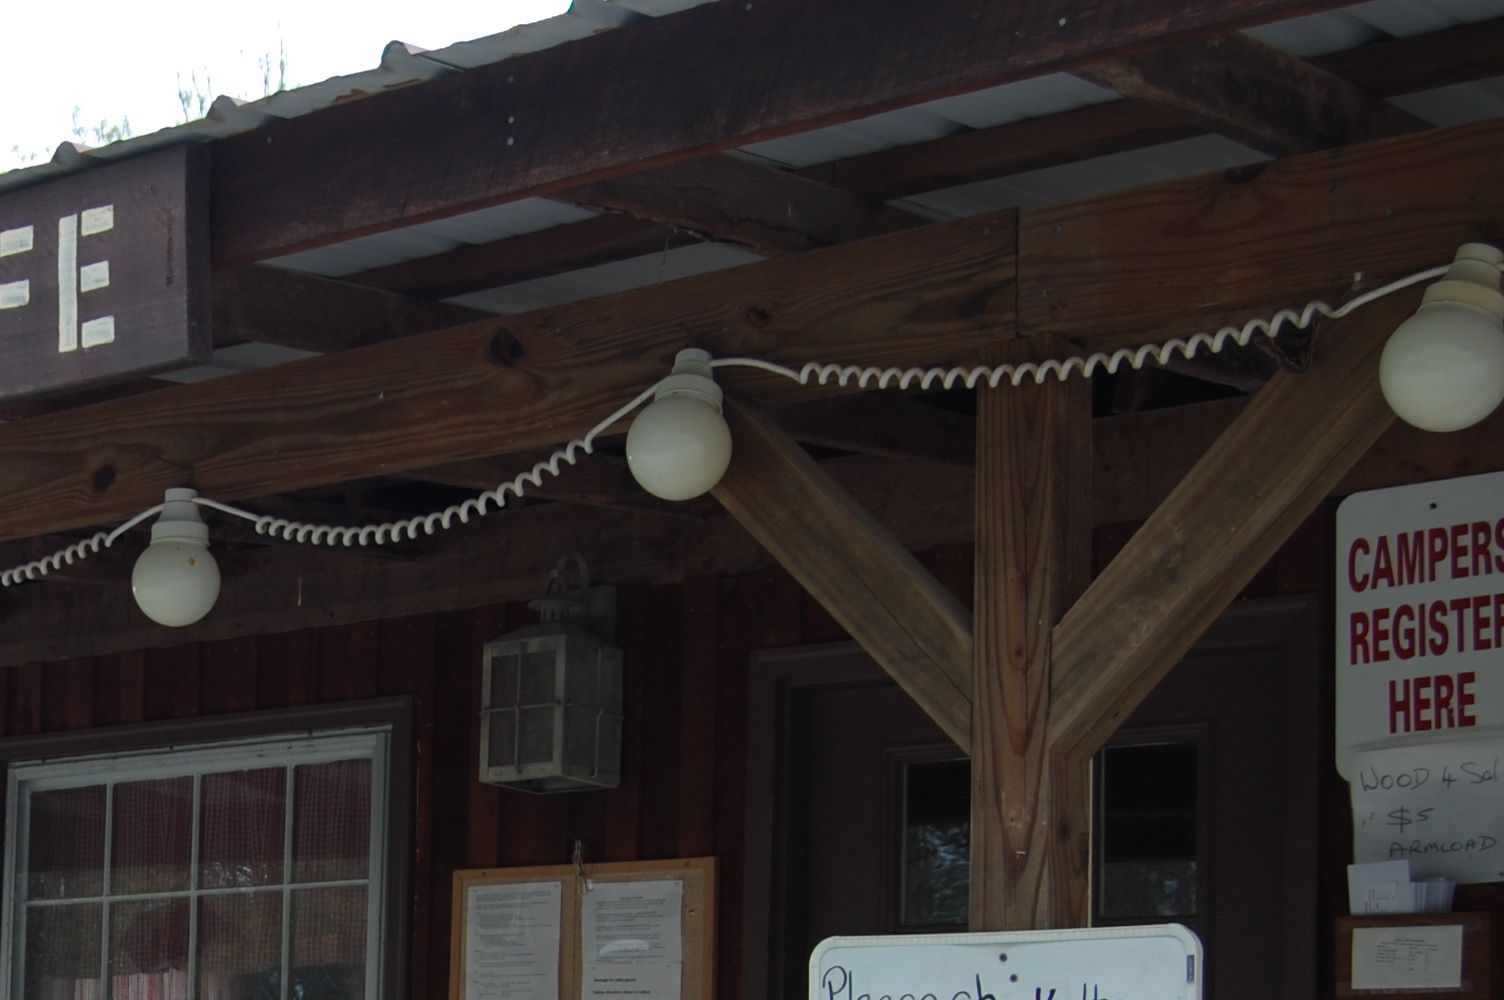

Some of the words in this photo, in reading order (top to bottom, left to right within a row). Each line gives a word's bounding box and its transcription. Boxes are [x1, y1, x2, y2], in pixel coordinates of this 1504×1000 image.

[1388, 672, 1477, 734] HERE
[1360, 766, 1430, 791] WOOD
[1442, 766, 1457, 790] 4
[1460, 758, 1504, 785] Sal
[1386, 805, 1435, 833] $5
[1389, 835, 1497, 858] ARMLOAD
